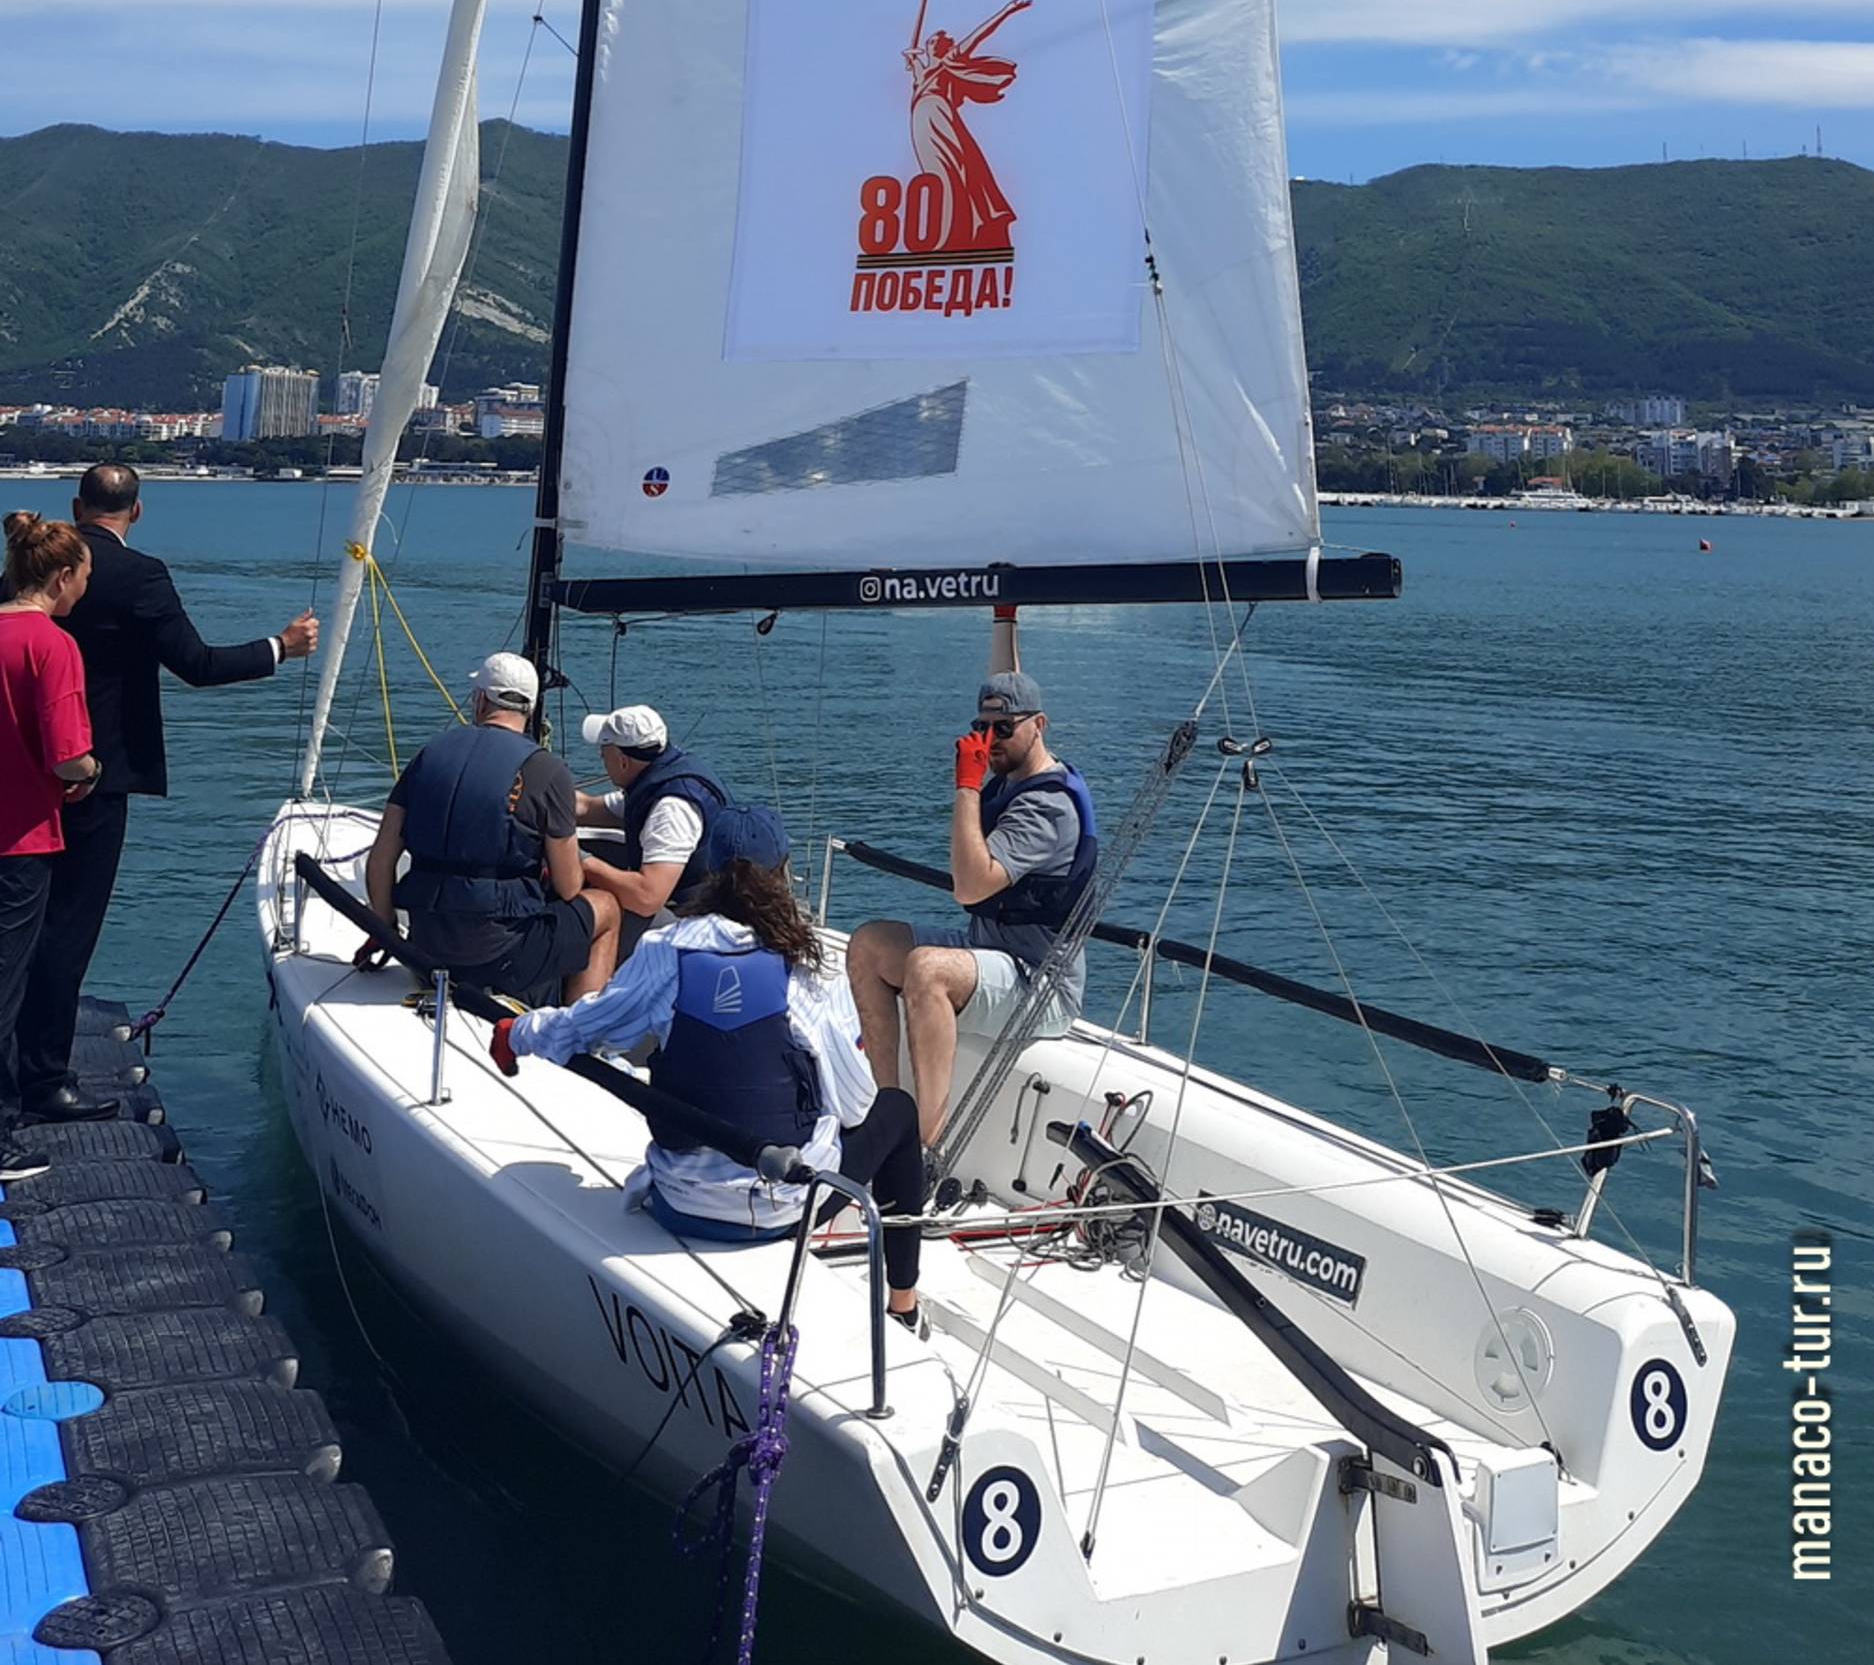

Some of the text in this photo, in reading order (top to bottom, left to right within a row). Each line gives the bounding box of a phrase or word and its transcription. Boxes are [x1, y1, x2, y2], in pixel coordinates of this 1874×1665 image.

[858, 173, 944, 255] 80
[850, 267, 1014, 318] ПОБЕДА!
[1216, 1211, 1358, 1292] navetru.com
[1643, 1370, 1676, 1440] 8
[982, 1480, 1023, 1563] 8
